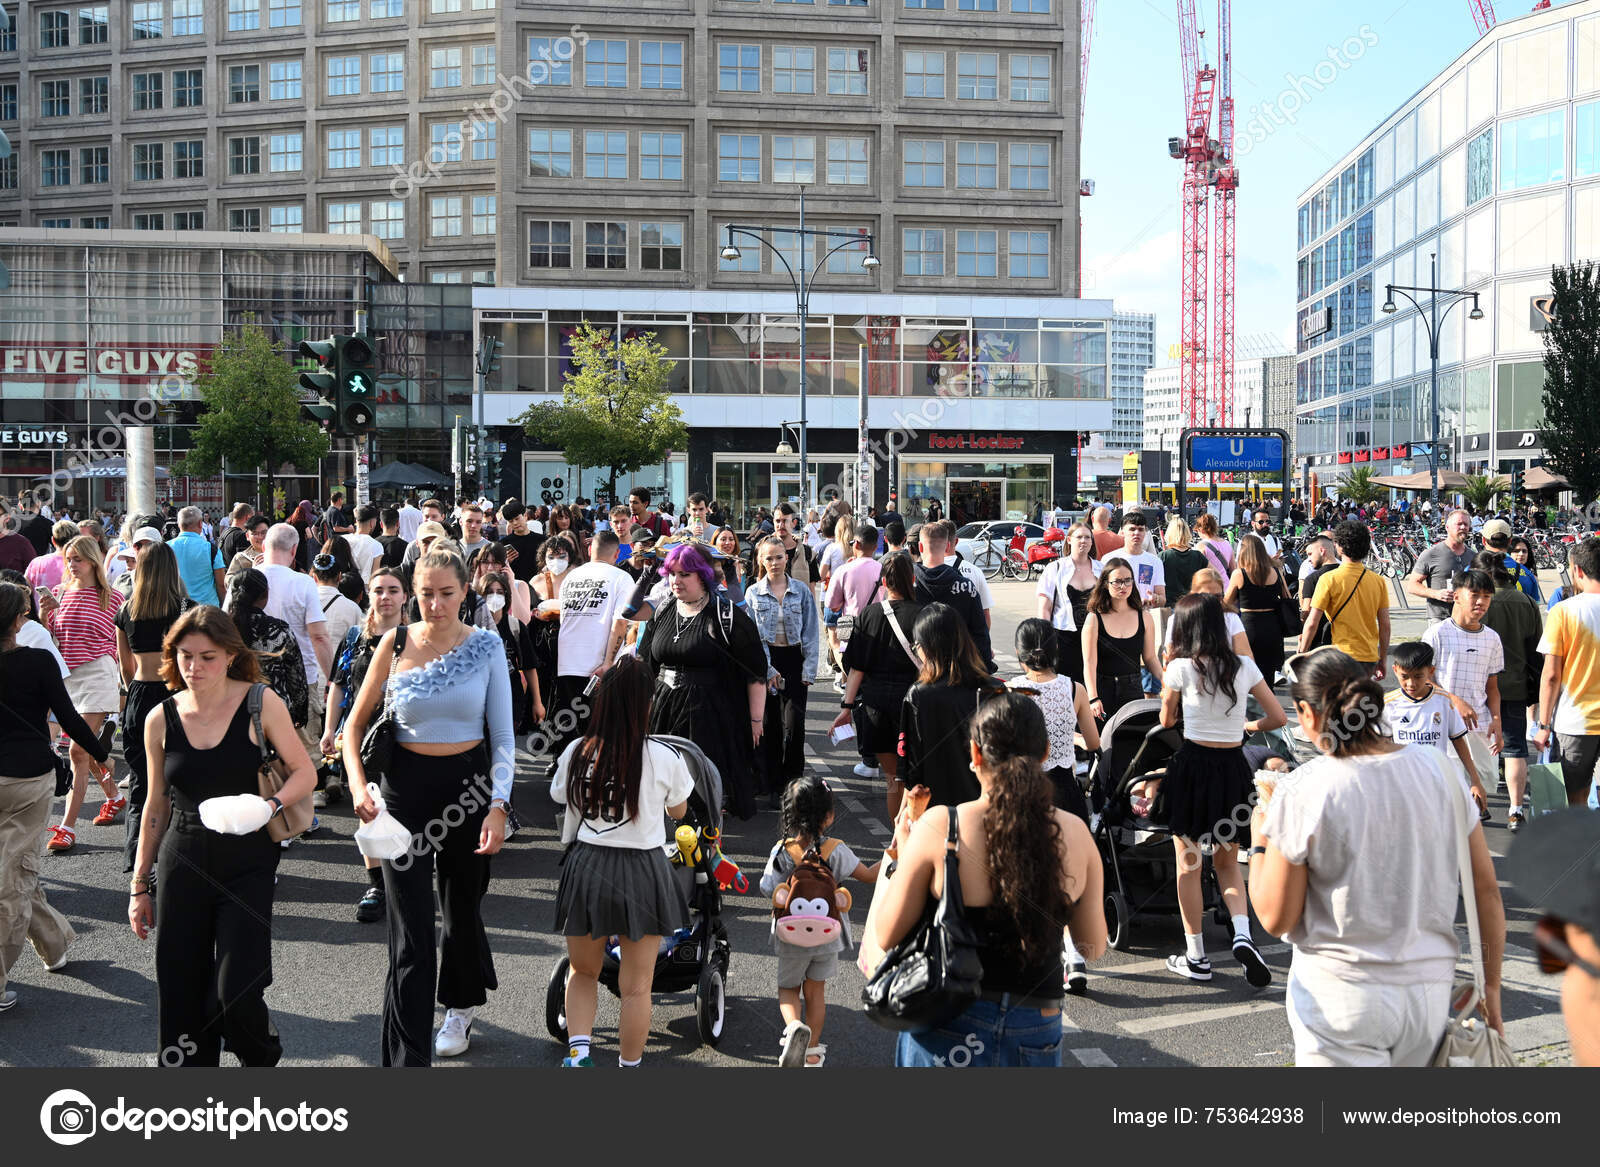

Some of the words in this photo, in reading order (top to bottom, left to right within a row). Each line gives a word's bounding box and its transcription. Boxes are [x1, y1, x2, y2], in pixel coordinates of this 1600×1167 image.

[4, 350, 87, 374] FIVE
[97, 350, 198, 374] GUYS
[0, 431, 13, 443] E
[18, 431, 68, 443] GUYS
[928, 433, 965, 448] Foot
[969, 433, 1024, 448] Locker
[1518, 433, 1536, 447] JD
[1230, 439, 1244, 457] U
[1205, 458, 1270, 469] Alexanderplatz
[190, 489, 222, 497] FRIES
